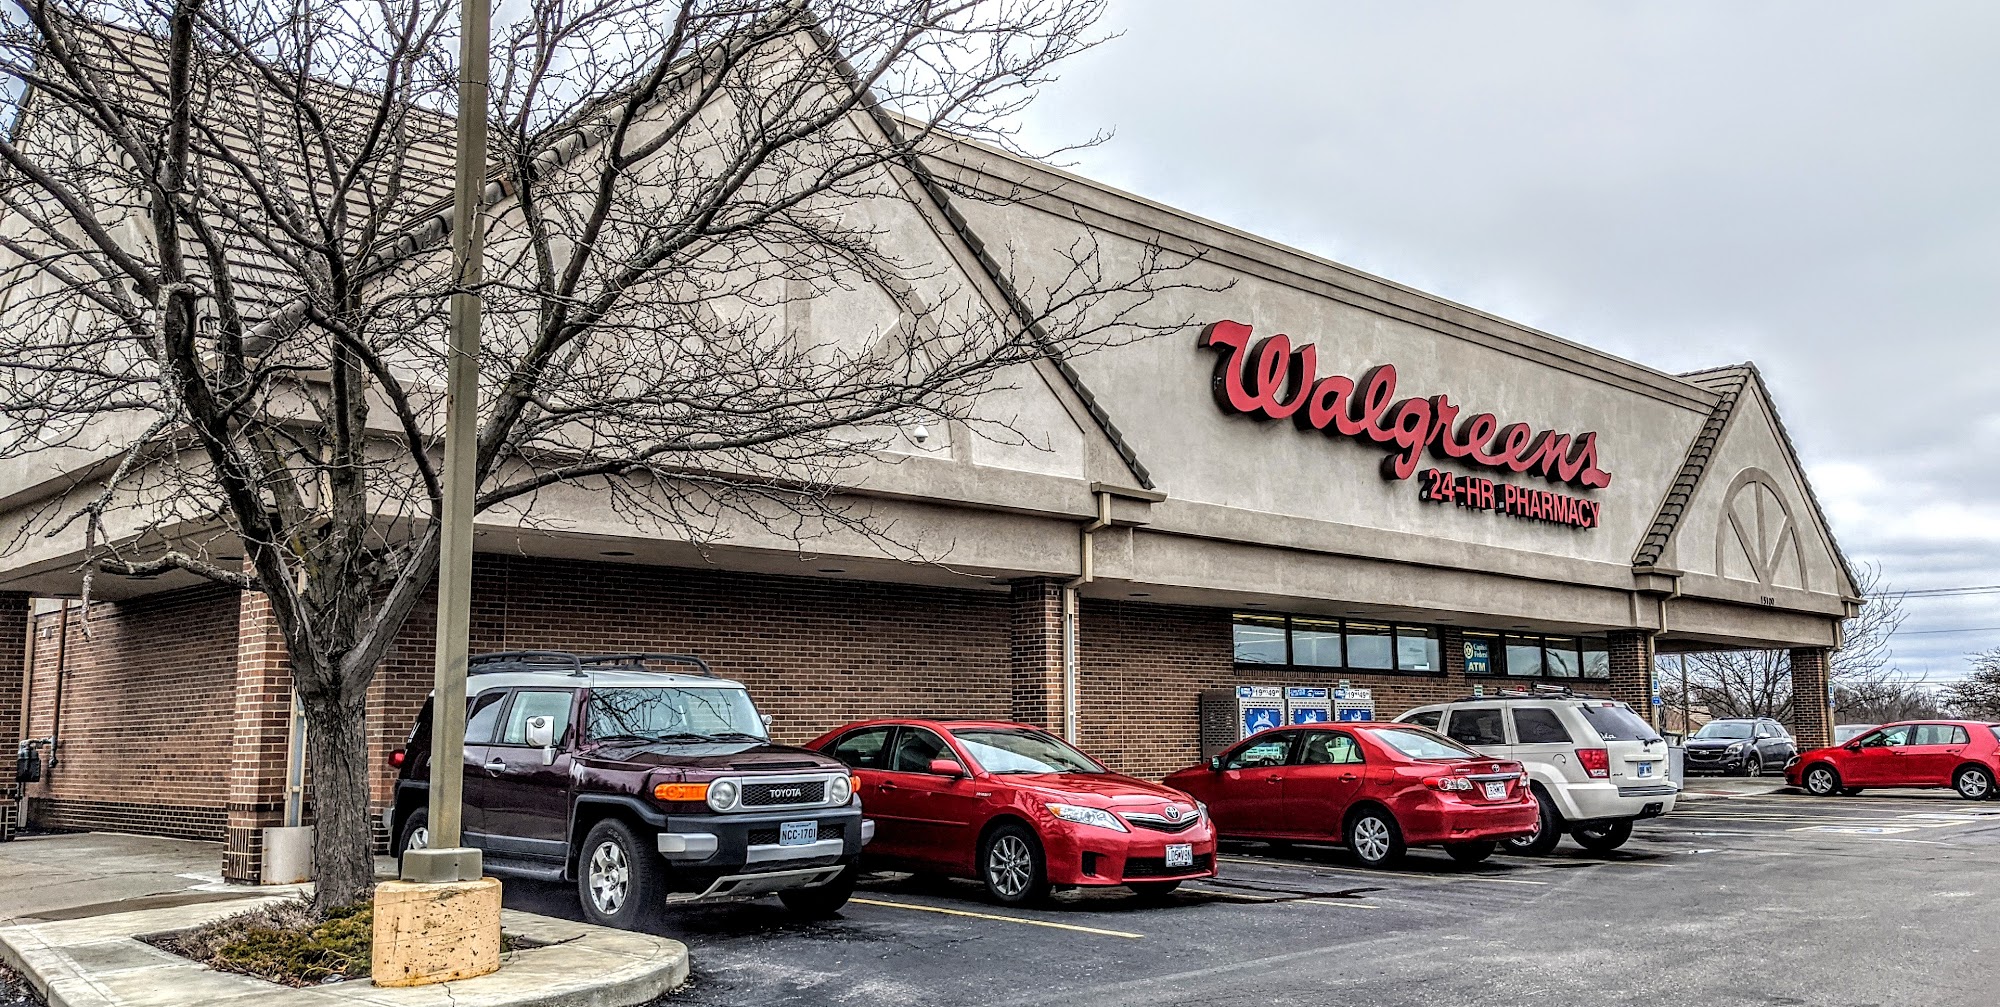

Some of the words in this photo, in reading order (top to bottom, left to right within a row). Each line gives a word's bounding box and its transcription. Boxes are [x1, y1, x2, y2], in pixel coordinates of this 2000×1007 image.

[1207, 320, 1612, 488] Walgreens
[1428, 468, 1495, 509] 24-HR
[1504, 484, 1600, 528] PHARMACY
[1468, 661, 1486, 672] ATM
[769, 788, 802, 798] TOYOTA
[782, 828, 816, 841] NCC-1701
